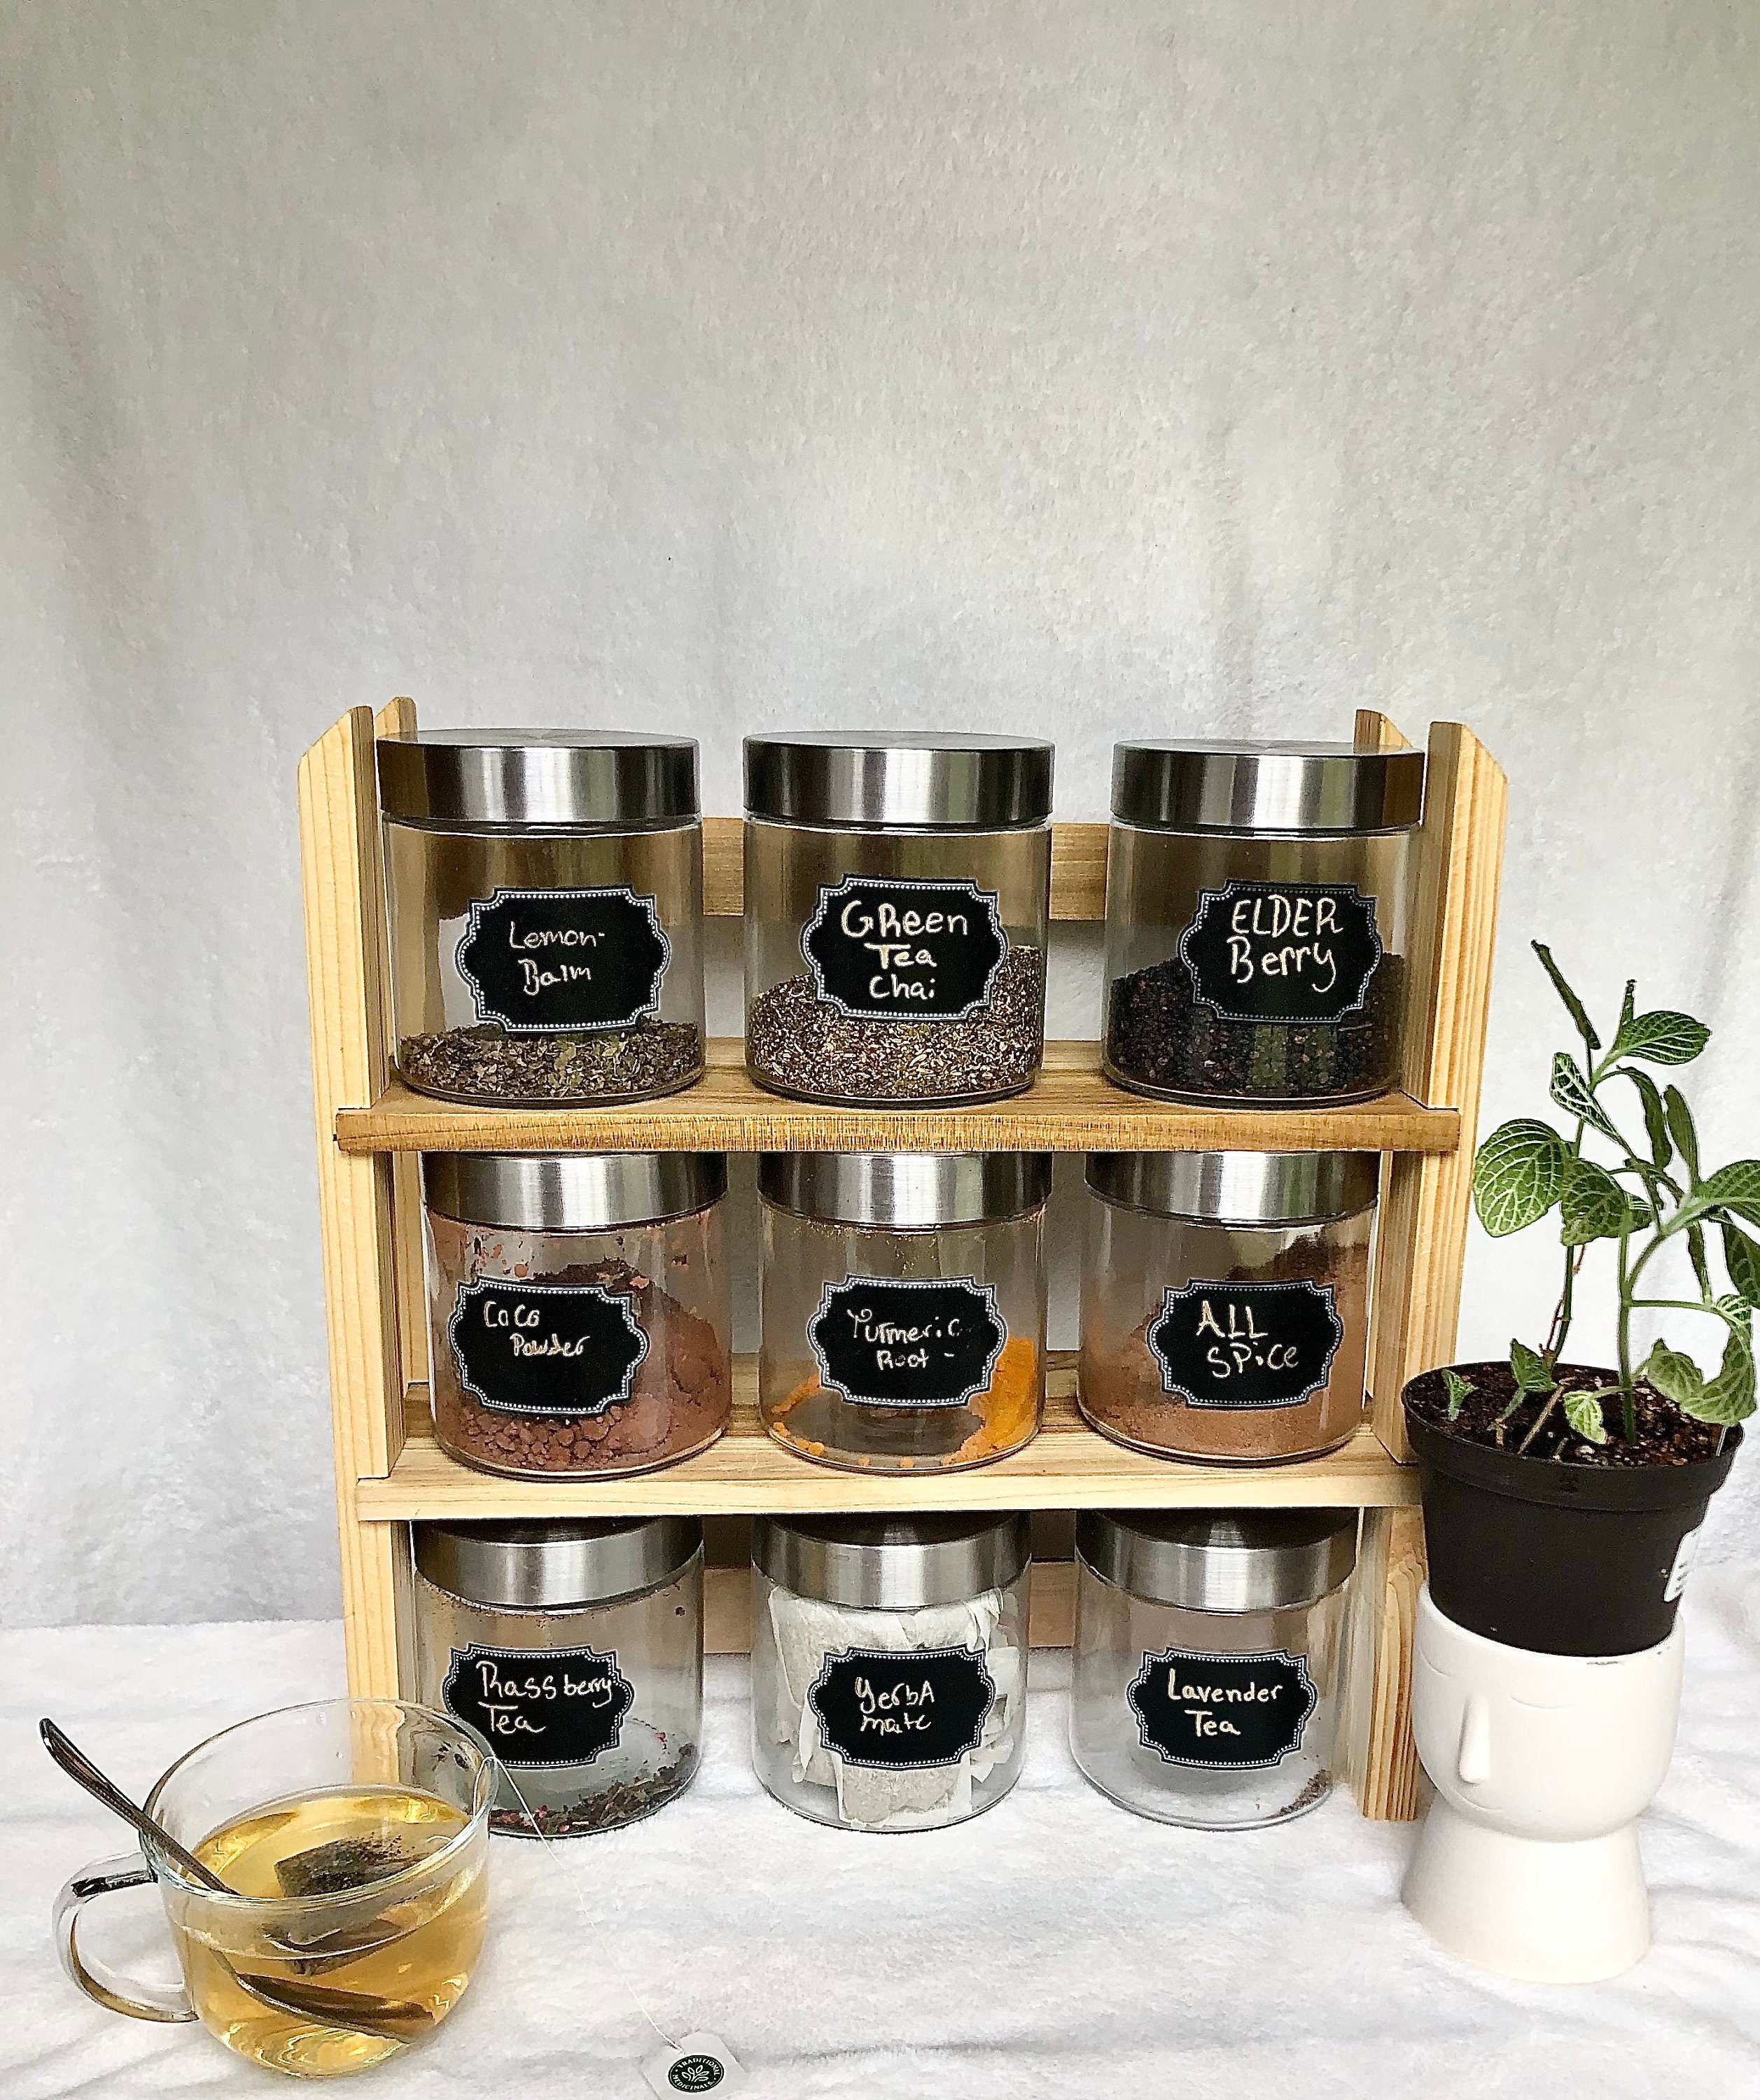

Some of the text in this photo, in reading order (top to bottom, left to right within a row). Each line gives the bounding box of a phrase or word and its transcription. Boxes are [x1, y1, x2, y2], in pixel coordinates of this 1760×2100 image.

[1231, 894, 1344, 938] ELDER
[863, 942, 938, 970] Tea
[1226, 935, 1337, 993] Berry
[517, 958, 592, 996] Balm
[869, 973, 936, 1000] Chai
[1195, 1300, 1269, 1340] ALL
[876, 1348, 930, 1371] Root
[1167, 1667, 1283, 1703] Lavender
[477, 1701, 547, 1735] Tea
[1184, 1709, 1241, 1738] Tea
[676, 2057, 720, 2075] TRADITIONAL
[672, 2074, 713, 2090] MEDICINALS
